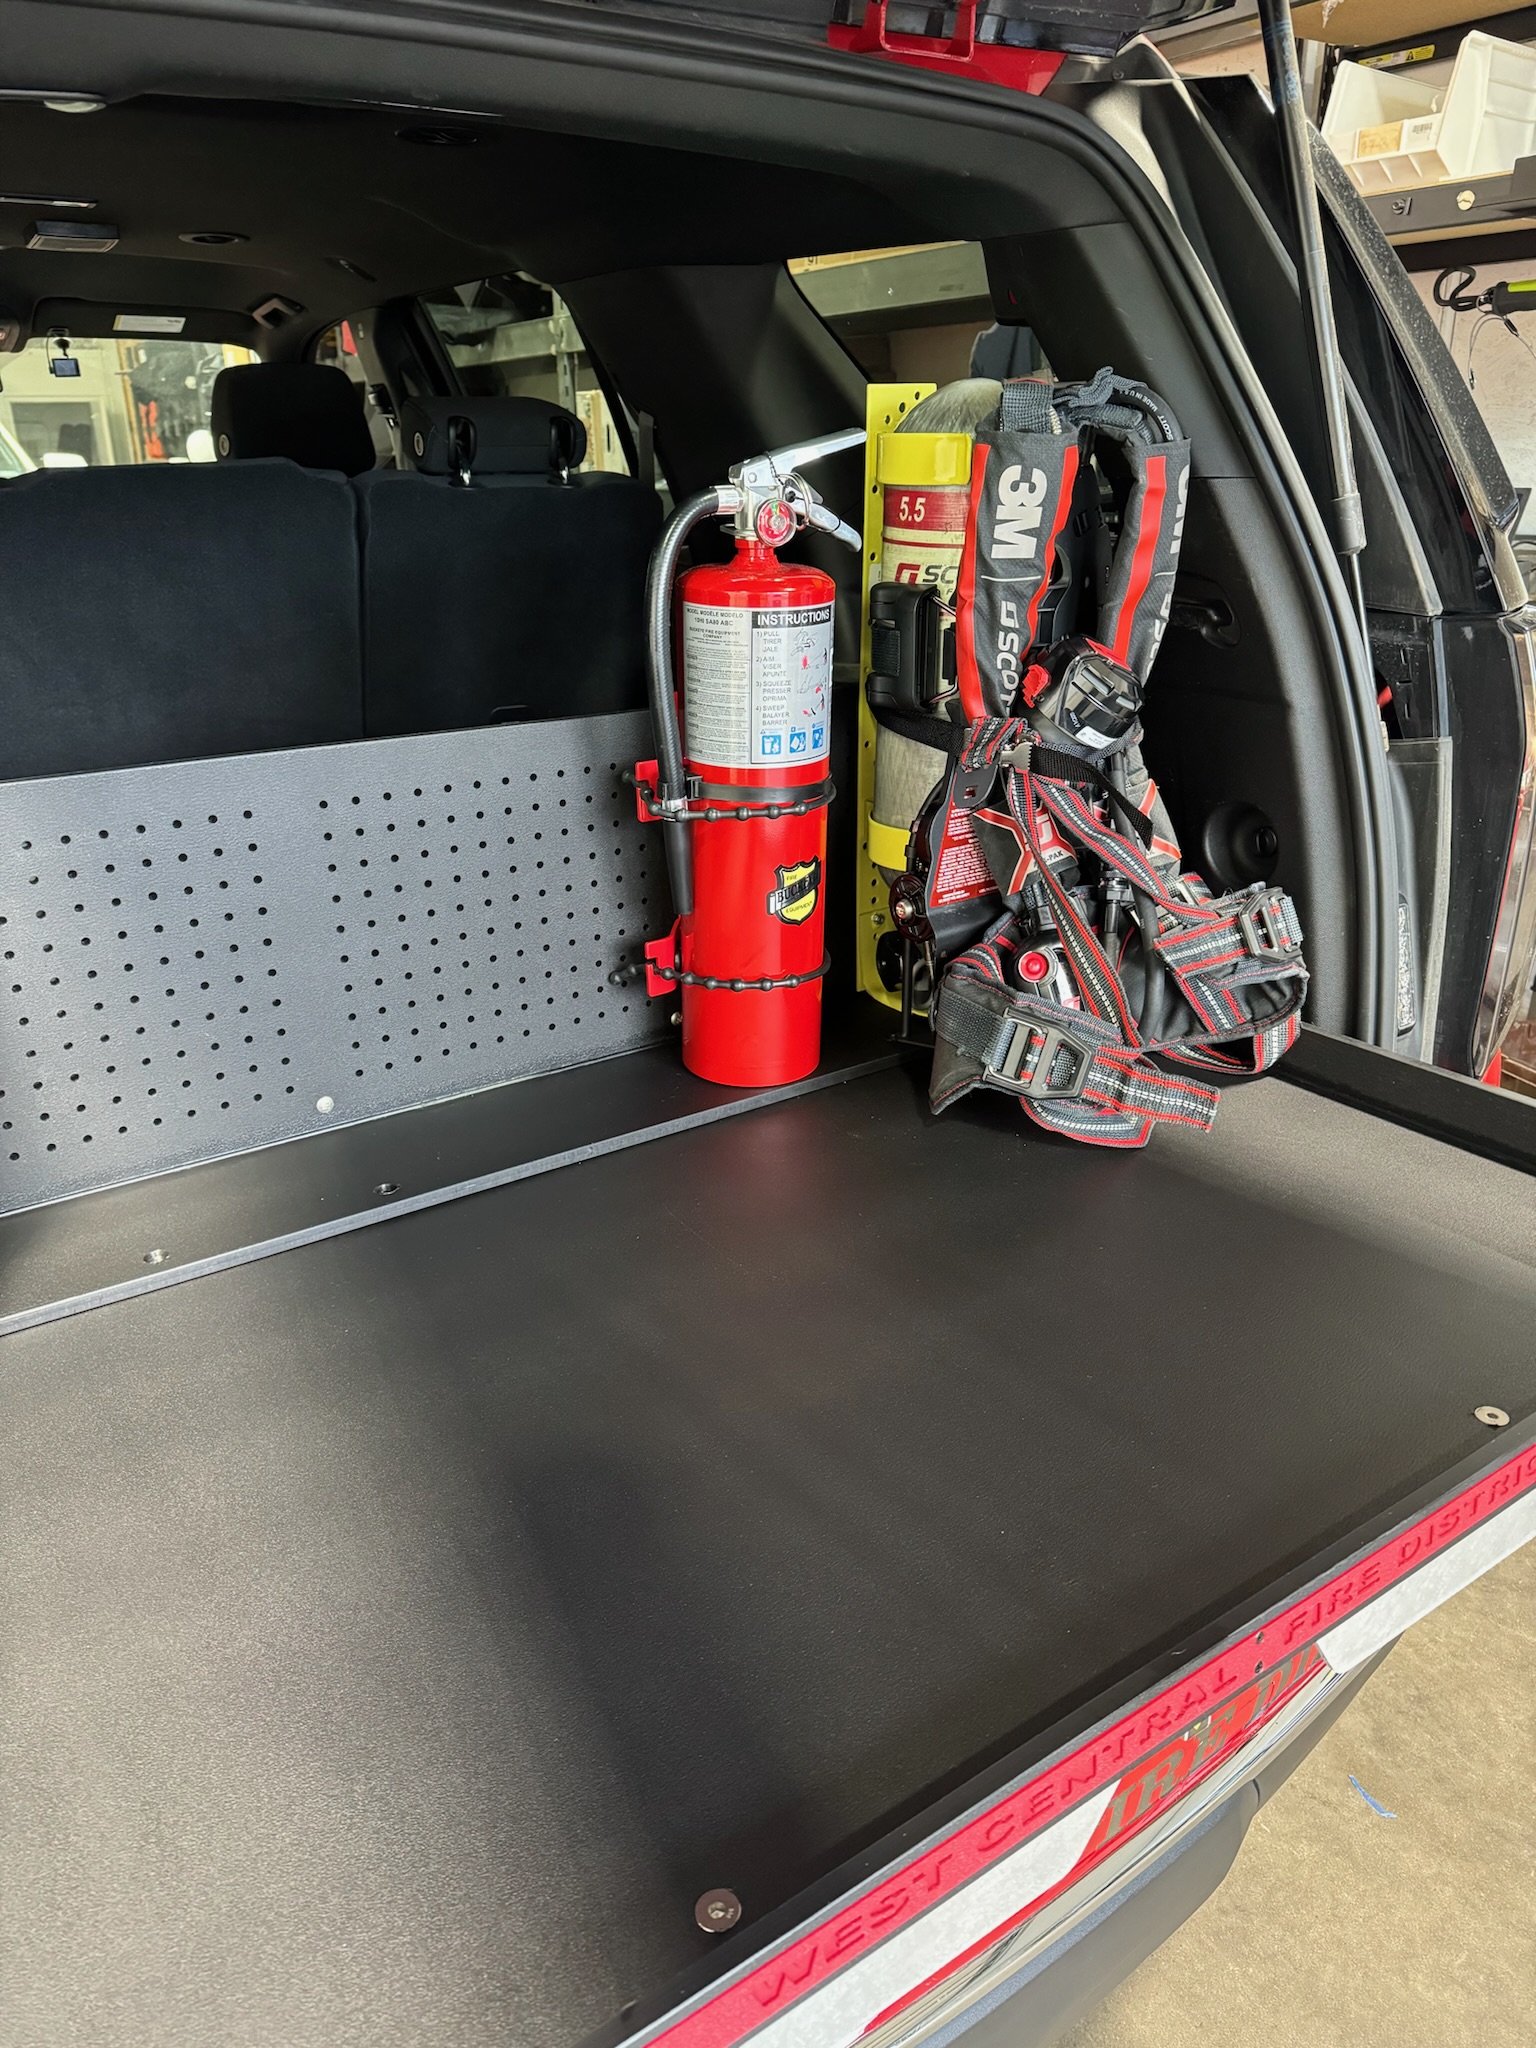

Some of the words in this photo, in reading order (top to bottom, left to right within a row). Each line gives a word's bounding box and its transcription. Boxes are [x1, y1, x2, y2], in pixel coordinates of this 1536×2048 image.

[1142, 395, 1158, 412] MADE
[1157, 415, 1174, 441] SCOTT
[899, 496, 926, 522] 5.5
[990, 464, 1048, 559] 3M
[757, 608, 830, 626] INSTRUCTIONS
[996, 630, 1020, 717] SCOT
[752, 1854, 953, 2007] WEST
[978, 1667, 1238, 1851] CENTRAL
[1283, 1562, 1381, 1646] FIRE
